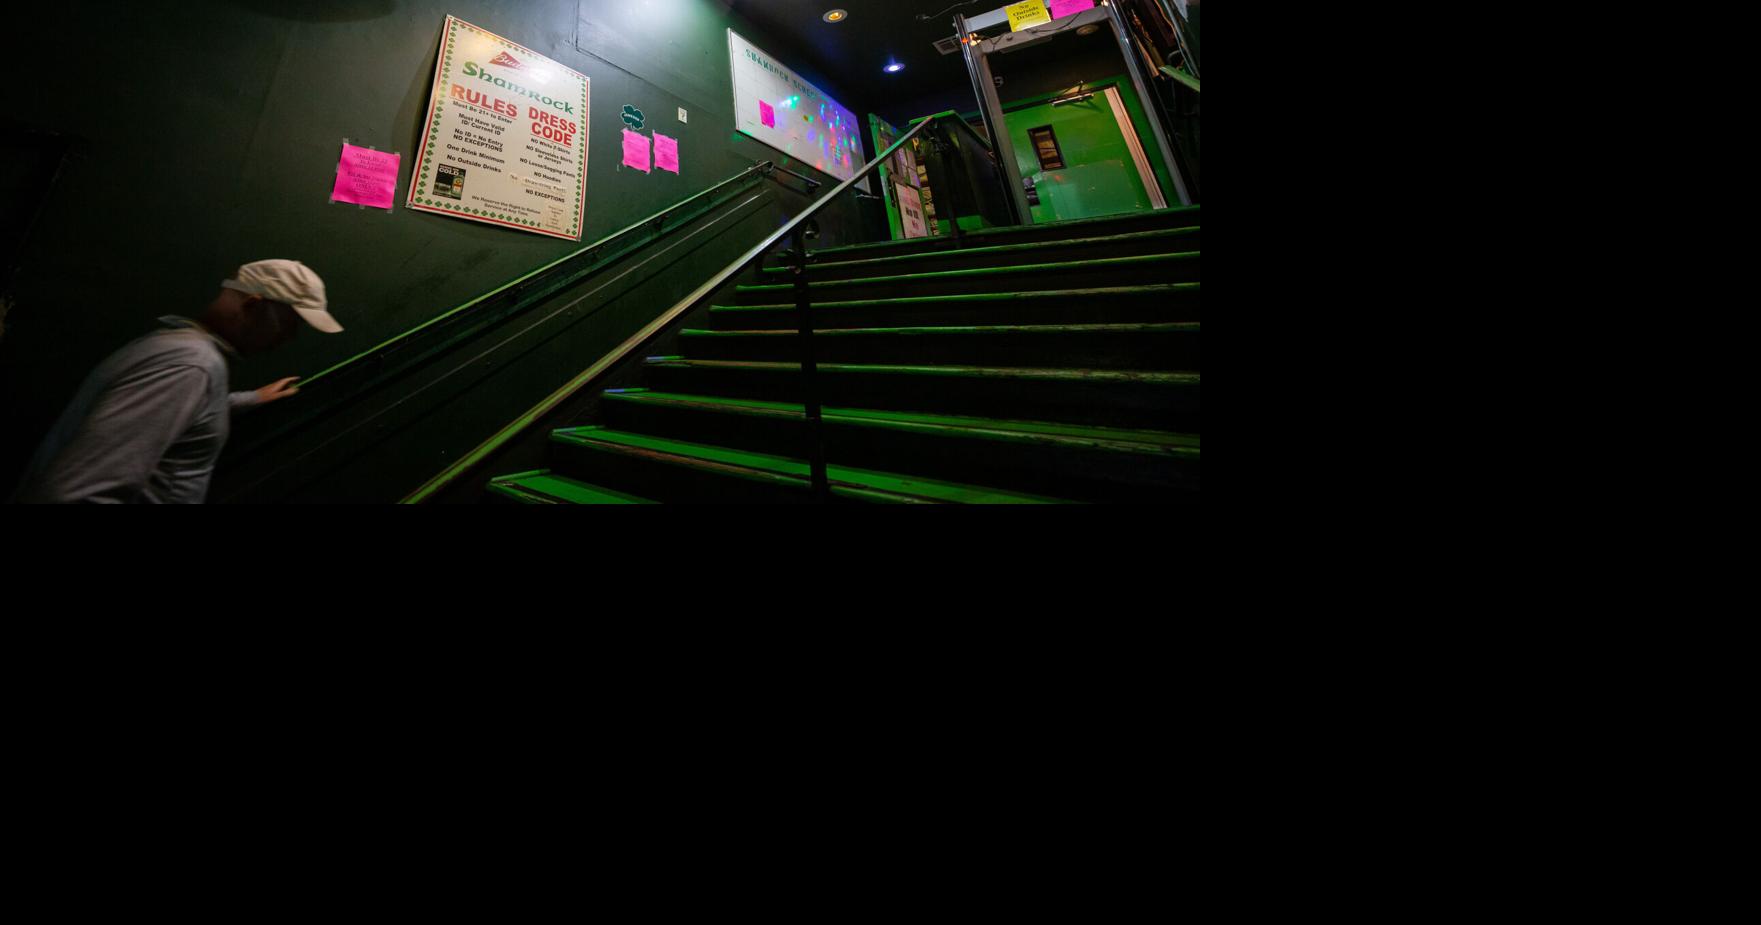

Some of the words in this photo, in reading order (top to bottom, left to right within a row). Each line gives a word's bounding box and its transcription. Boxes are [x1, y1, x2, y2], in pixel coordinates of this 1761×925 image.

[1013, 6, 1039, 17] Outside
[1016, 11, 1040, 20] Drinks
[451, 84, 517, 117] RULES
[453, 101, 468, 110] Must
[498, 115, 513, 124] Enter
[459, 113, 473, 121] Must
[475, 118, 489, 126] Have
[491, 123, 505, 132] Valid
[529, 106, 577, 134] DRESS
[471, 122, 493, 133] Current
[532, 122, 572, 146] CODE
[464, 137, 503, 153] EXCEPTIONS
[488, 138, 504, 148] Entry
[540, 140, 552, 148] White
[446, 143, 460, 151] One
[461, 147, 477, 156] Drink
[479, 152, 505, 164] Minimum
[535, 147, 559, 159] Sleeveless
[560, 155, 573, 164] Shirts
[457, 157, 481, 167] Outside
[482, 163, 502, 173] Drinks
[544, 155, 562, 165] Jerseys
[438, 167, 460, 176] COLD
[563, 170, 576, 178] Pants
[542, 173, 561, 183] Hoodies
[480, 197, 500, 205] Reserve
[534, 191, 565, 203] EXCEPTIONS
[484, 203, 502, 211] Service
